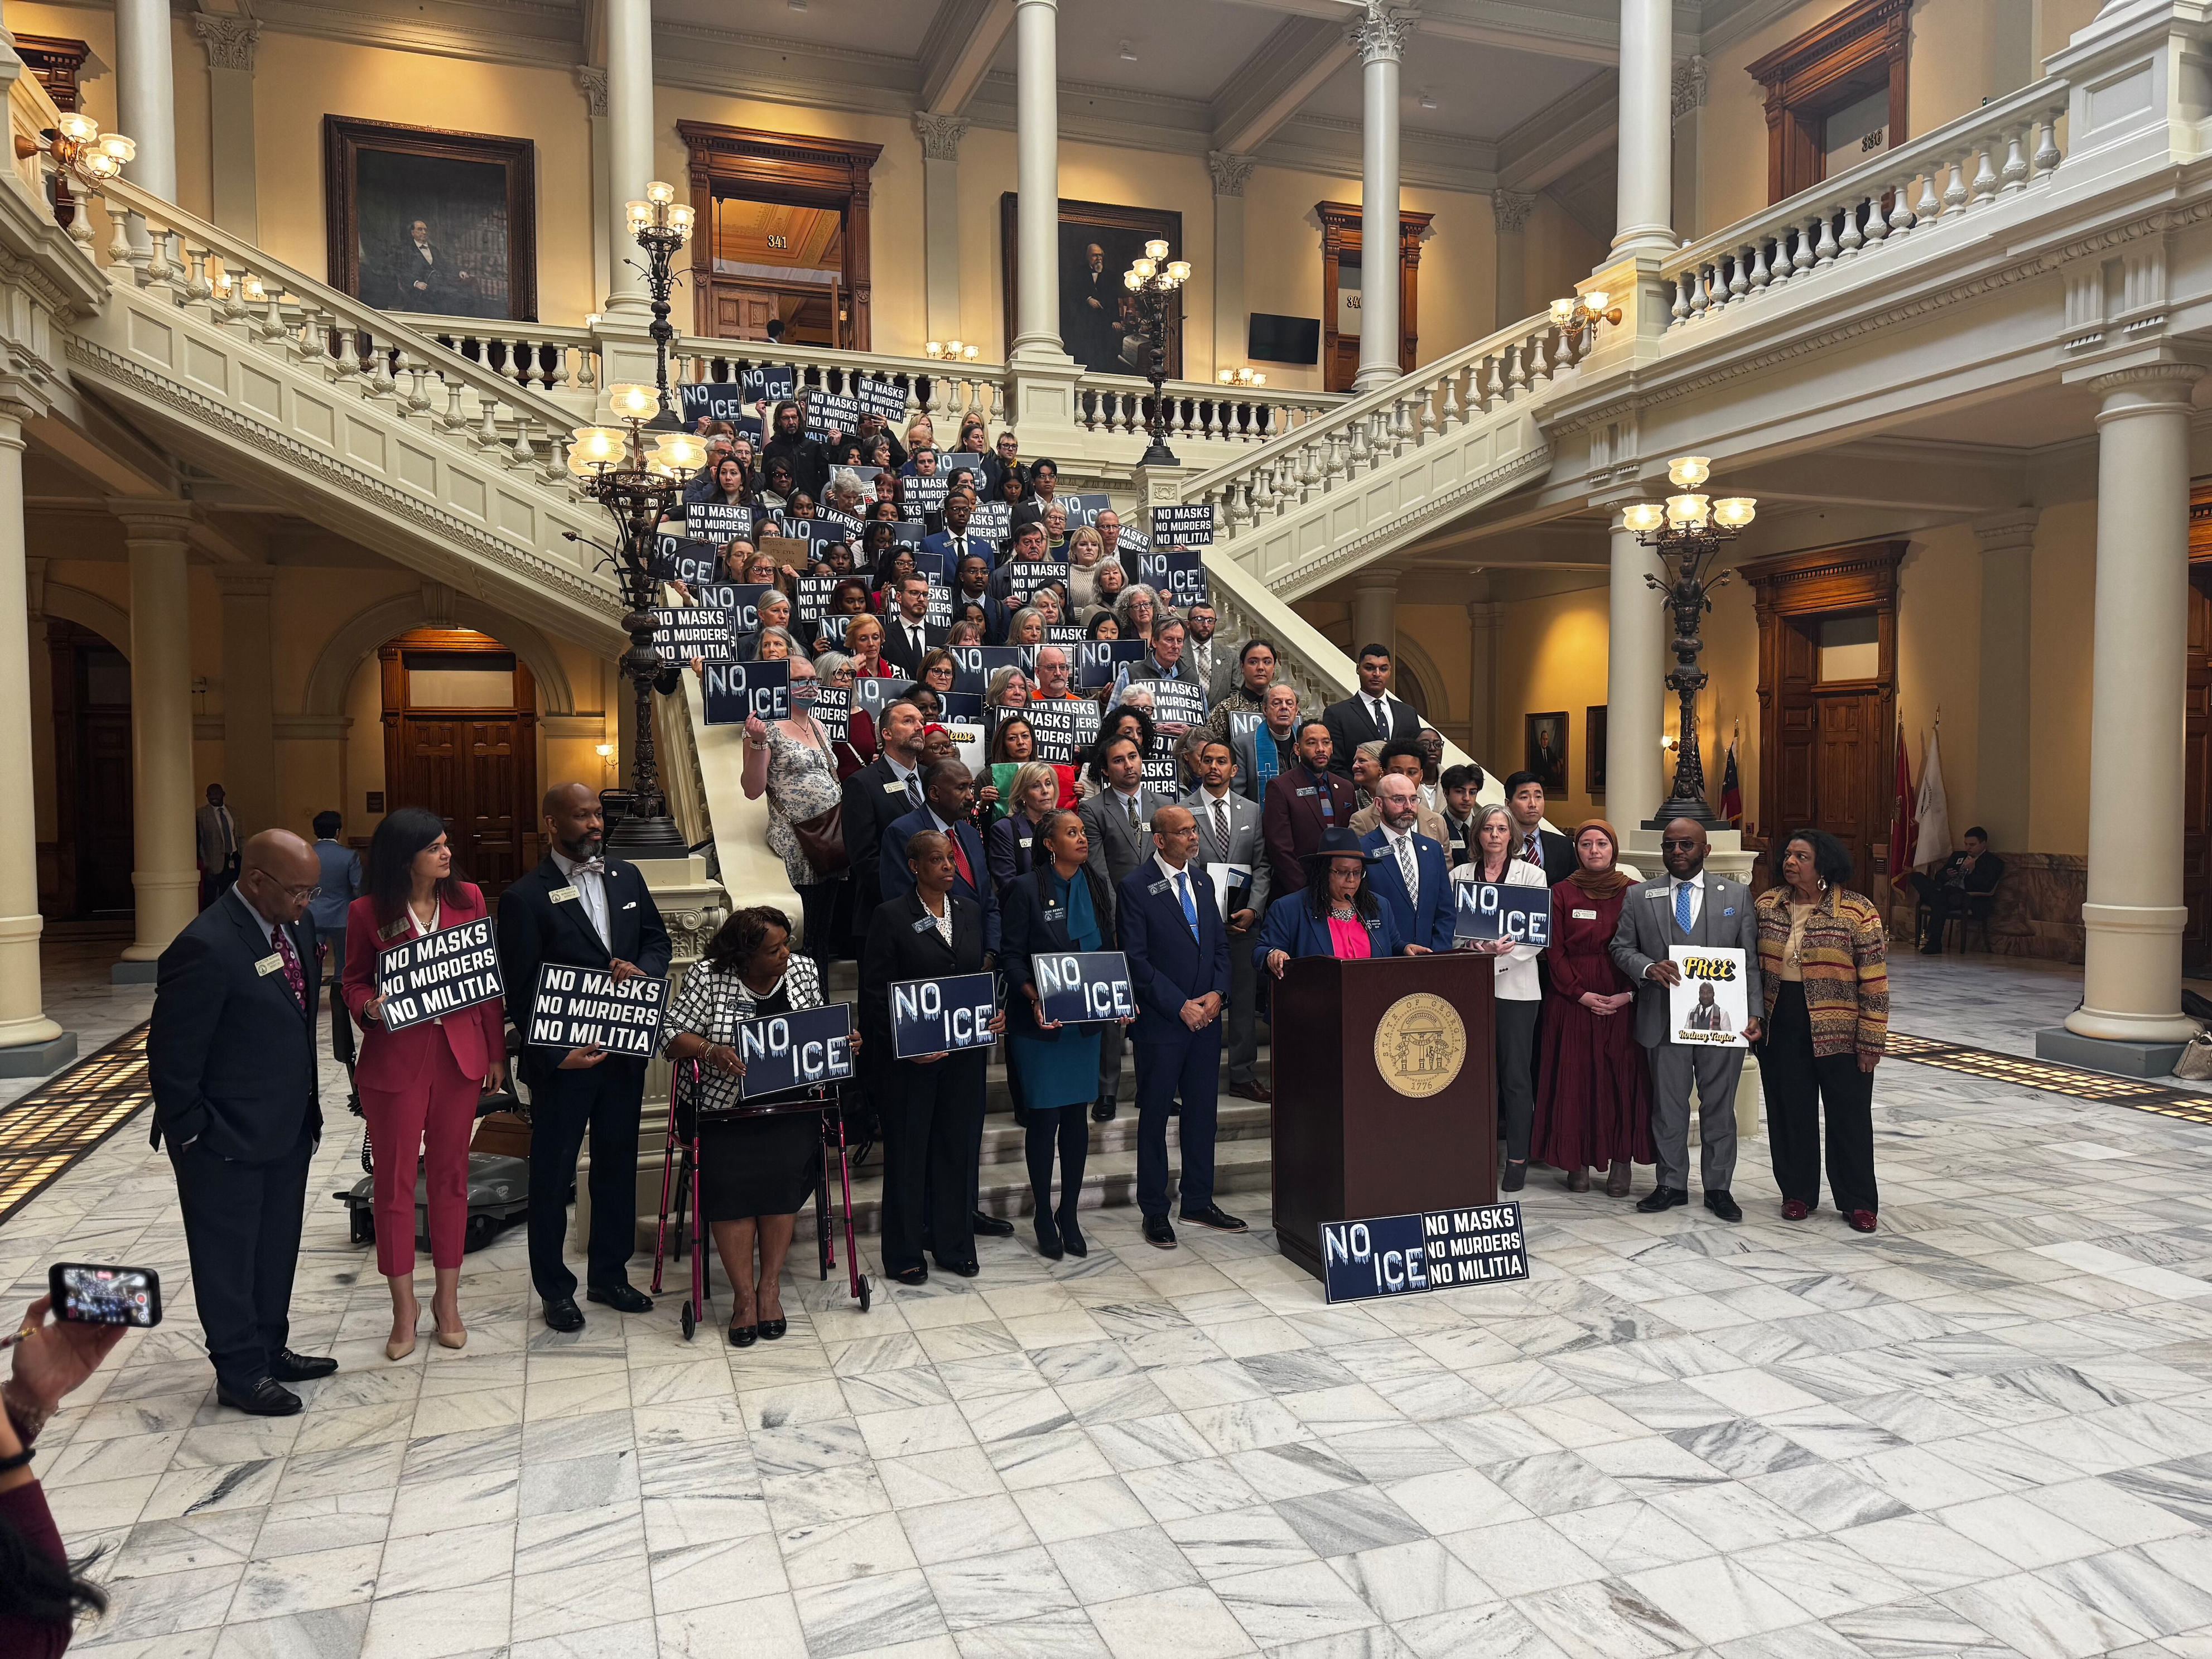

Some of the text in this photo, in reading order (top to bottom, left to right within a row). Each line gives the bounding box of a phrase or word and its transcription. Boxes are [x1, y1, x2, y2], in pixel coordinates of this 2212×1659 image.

[1862, 129, 1882, 152] 336
[768, 234, 787, 249] 341
[743, 370, 764, 389] NO
[683, 385, 709, 406] NO
[765, 382, 792, 399] ICE
[862, 380, 904, 399] NO MASKS
[710, 399, 739, 418] ICE
[811, 393, 857, 411] NO MASKS
[860, 390, 904, 409] NO MURDERS
[809, 405, 858, 422] NO MURDERS
[809, 416, 855, 434] NO MILITIA
[907, 479, 948, 488] NO MASK
[905, 490, 949, 499] NO MURDE
[690, 505, 747, 519] NO MASKS
[903, 505, 921, 515] SKS
[1158, 507, 1209, 519] NO MASKS
[688, 519, 750, 531] NO MURDERS
[970, 514, 994, 525] ASKS
[1156, 520, 1211, 531] NO MURDERS
[783, 519, 810, 539] NO
[968, 527, 996, 537] RDERS
[1157, 532, 1209, 544] NO MILITIA
[811, 538, 840, 560] IC
[1117, 537, 1146, 552] URDERS
[1014, 565, 1066, 576] NO MASKS
[1140, 554, 1167, 576] NO
[801, 580, 816, 592] NO
[1013, 578, 1024, 588] NO
[1168, 570, 1198, 592] ICE
[702, 587, 734, 610] NO
[799, 594, 813, 605] NO
[928, 589, 948, 600] SKS
[653, 611, 724, 625] NO MASKS
[737, 605, 758, 630] IC
[802, 608, 817, 620] NO
[653, 629, 728, 642] NO MURDERS
[656, 644, 729, 659] NO MILITIA
[1082, 643, 1111, 667] NO
[952, 649, 982, 673] NO
[708, 665, 746, 696] NO
[815, 689, 846, 705] ASKS
[1160, 682, 1199, 698] MASKS
[749, 686, 787, 718] ICE
[1053, 702, 1095, 715] MASKS
[1157, 696, 1202, 710] MURDERS
[809, 707, 847, 721] URDERS
[1023, 711, 1071, 729] MASKS
[1160, 709, 1203, 725] MILITIA
[948, 729, 976, 744] lease
[1035, 730, 1072, 744] RDERS
[1037, 745, 1069, 761] LITIA
[1141, 763, 1172, 777] ASKS
[1458, 883, 1498, 915] NO
[1499, 909, 1547, 943] ICE
[385, 923, 488, 974] NO MASKS
[382, 948, 495, 996] NO MURDERS
[1039, 957, 1081, 992] NO
[1683, 957, 1736, 981] FREE
[545, 968, 660, 1002] NO MASKS
[387, 972, 500, 1024] NO MILITIA
[895, 982, 941, 1024] NO
[1084, 981, 1131, 1018] ICE
[537, 995, 658, 1026] NO MURDERS
[1406, 1012, 1437, 1025] CONSTITUTION
[944, 1004, 992, 1048] ICE
[1382, 999, 1461, 1057] STATE OF GEORGIA
[534, 1019, 649, 1052] NO MILITIA
[741, 1018, 789, 1063] NO
[1679, 1030, 1736, 1044] Rodney Taylor
[792, 1036, 849, 1083] ICE
[1411, 1081, 1432, 1090] 1776
[1425, 1208, 1514, 1236] NO MASKS
[1326, 1223, 1371, 1266] NO
[1428, 1232, 1520, 1258] NO MURDERS
[1374, 1247, 1426, 1293] ICE
[1430, 1255, 1522, 1284] NO MILITIA
